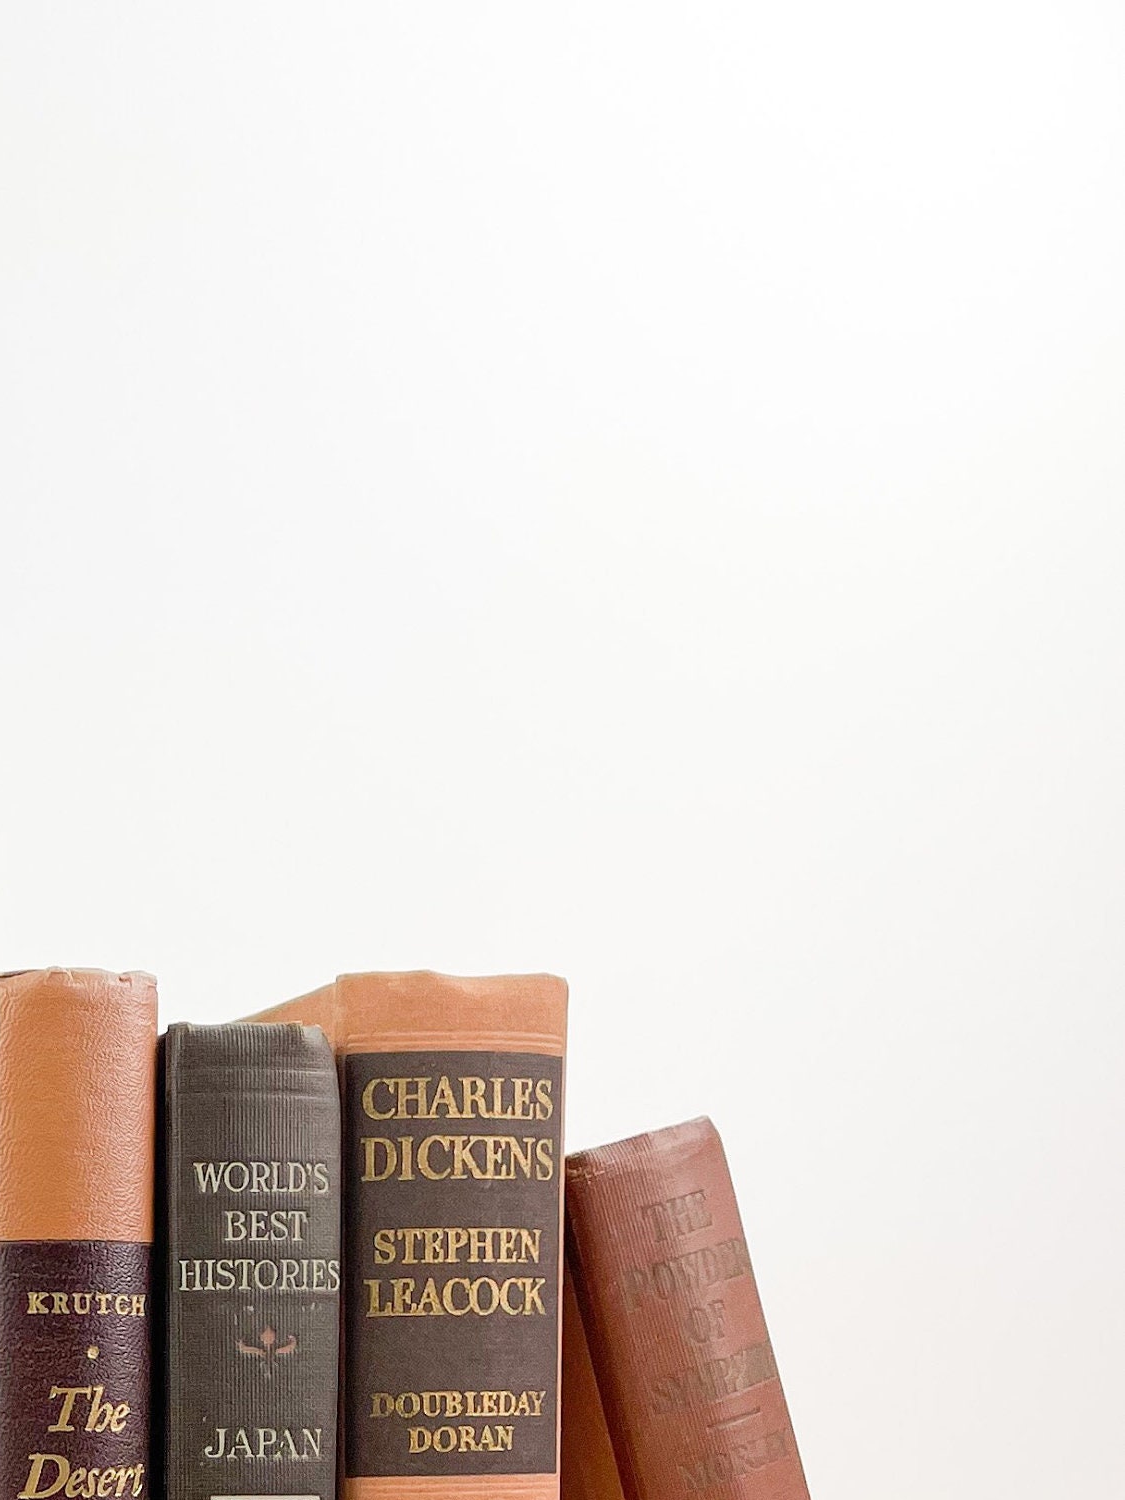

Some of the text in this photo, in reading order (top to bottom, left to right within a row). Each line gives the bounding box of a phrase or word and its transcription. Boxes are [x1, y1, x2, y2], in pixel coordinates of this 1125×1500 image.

[361, 1075, 554, 1121] CHARLES
[361, 1134, 554, 1182] DICKENS
[193, 1162, 329, 1194] WORLD'S
[225, 1210, 308, 1241] BEST
[643, 1190, 712, 1243] THE
[374, 1227, 542, 1264] STEPHEN
[179, 1259, 340, 1291] HISTORIES
[26, 1292, 146, 1317] KRUTCH
[364, 1277, 546, 1317] LEACOCK
[685, 1300, 725, 1343] OF
[48, 1385, 131, 1433] The
[370, 1391, 545, 1419] DOUBLEDAY
[204, 1428, 321, 1459] JAPAN
[408, 1424, 513, 1454] DORAN
[17, 1452, 144, 1500] Desert
